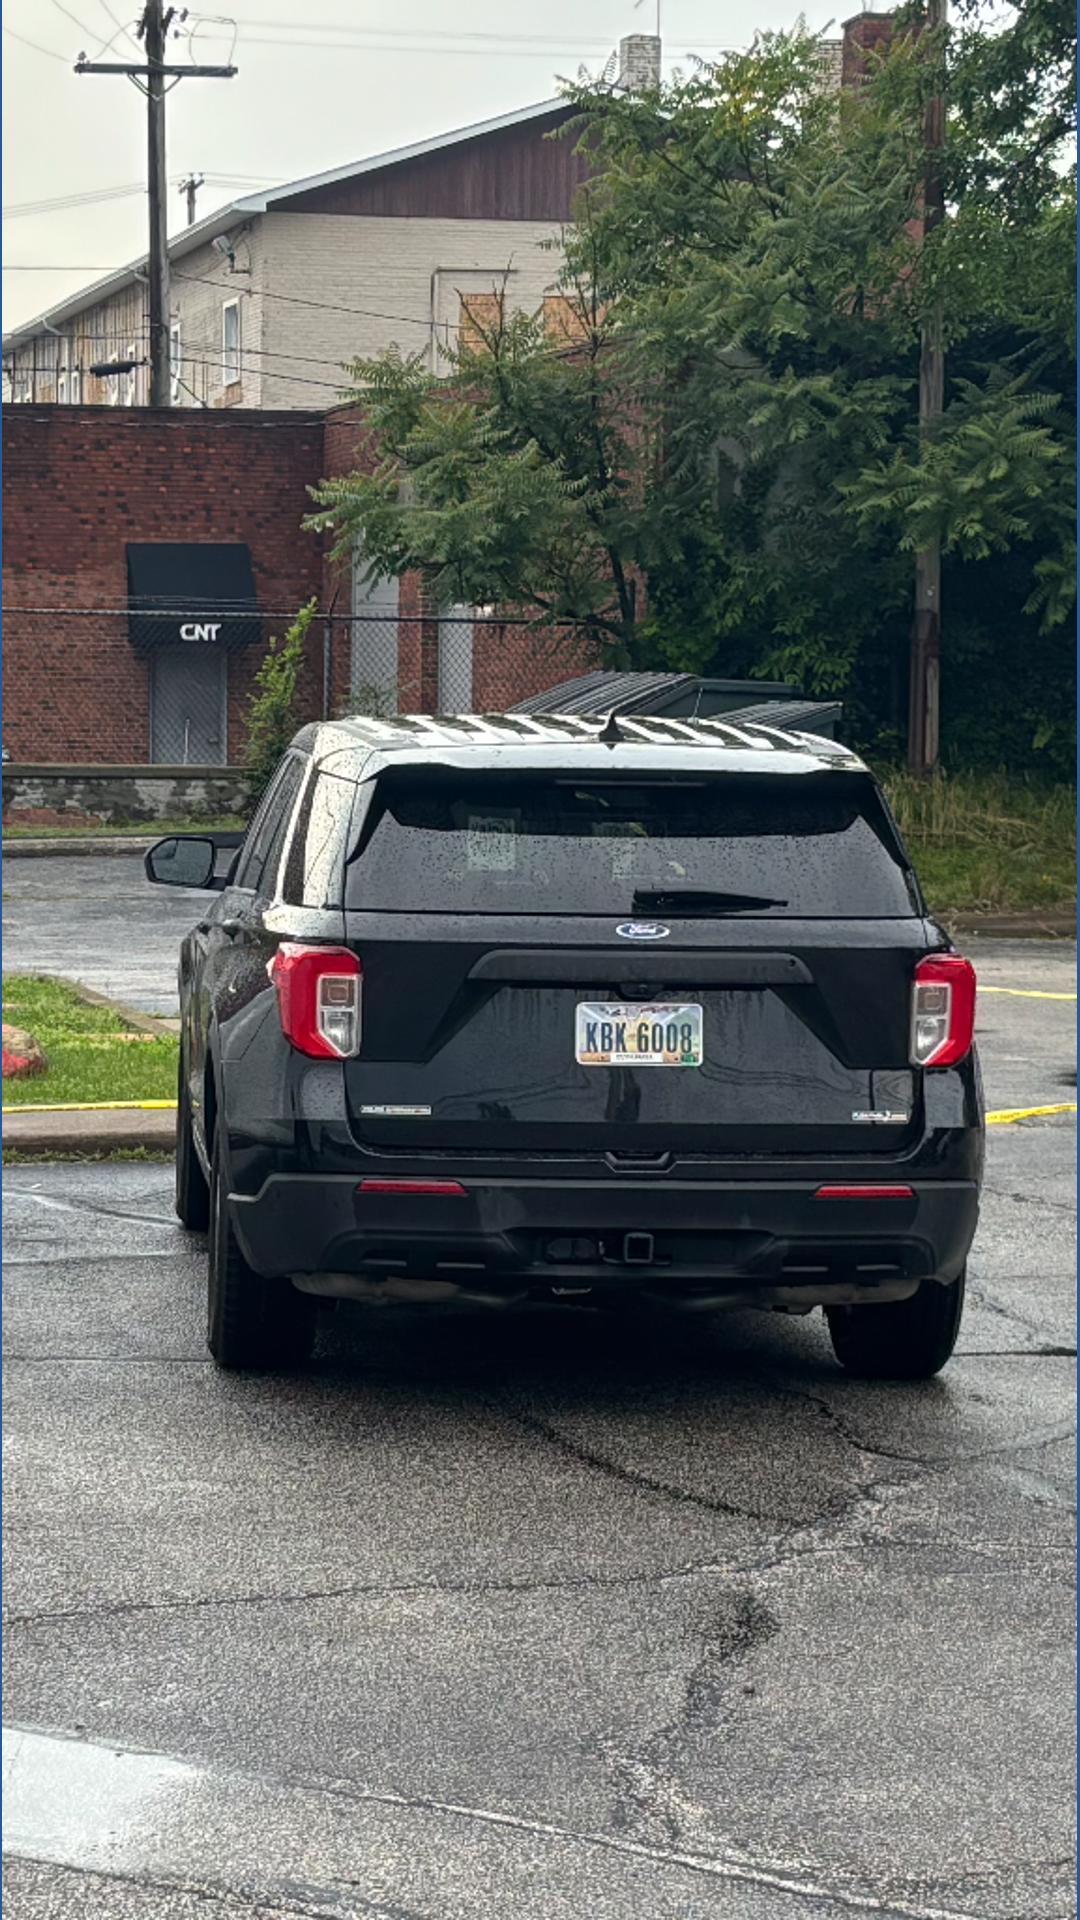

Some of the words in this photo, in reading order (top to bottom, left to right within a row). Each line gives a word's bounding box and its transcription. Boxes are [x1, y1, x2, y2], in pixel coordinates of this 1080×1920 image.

[180, 623, 222, 641] CNT
[586, 1022, 626, 1053] KBK
[637, 1022, 692, 1054] 6008
